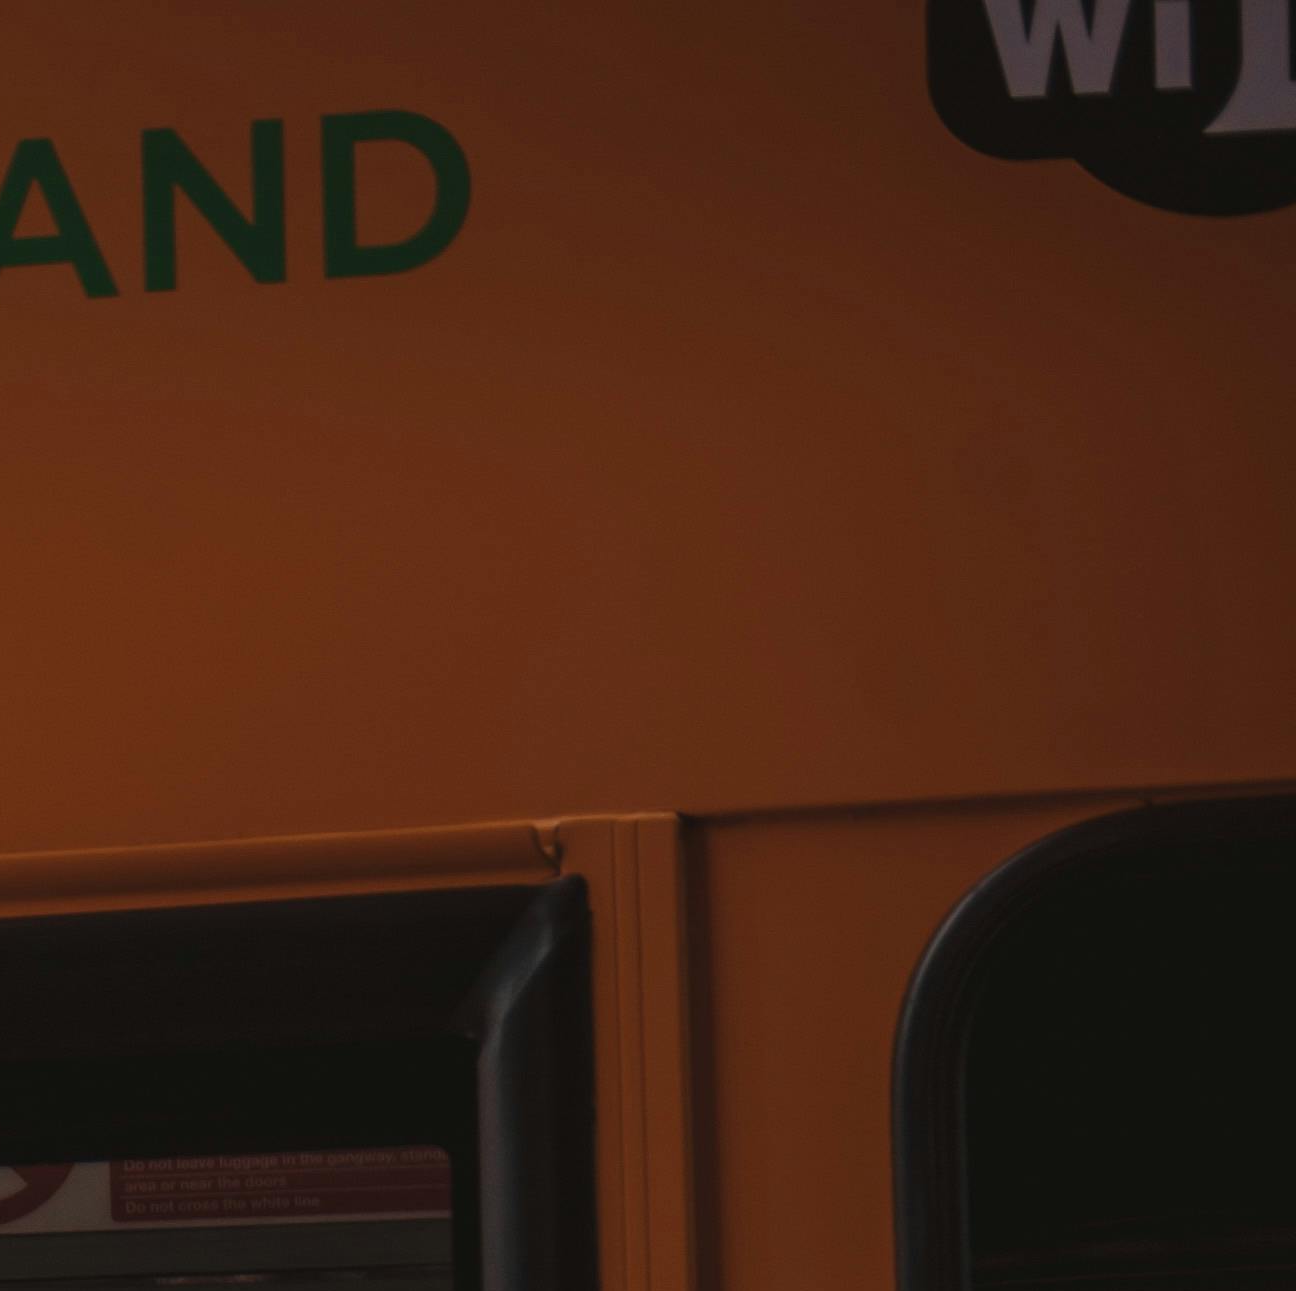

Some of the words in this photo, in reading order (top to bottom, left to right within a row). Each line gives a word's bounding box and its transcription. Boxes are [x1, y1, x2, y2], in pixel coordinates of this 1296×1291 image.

[124, 1159, 144, 1171] Do
[148, 1158, 172, 1170] not
[176, 1157, 215, 1169] leave
[219, 1155, 278, 1171] luggage
[282, 1152, 295, 1165] in
[300, 1152, 323, 1165] the
[160, 1181, 175, 1192] or
[181, 1179, 214, 1191] near
[218, 1176, 241, 1190] the
[245, 1175, 287, 1188] doors
[126, 1200, 146, 1213] Do
[150, 1199, 174, 1213] not
[178, 1200, 219, 1211] cross
[223, 1197, 247, 1210] the
[251, 1196, 290, 1209] white
[295, 1195, 320, 1208] line
